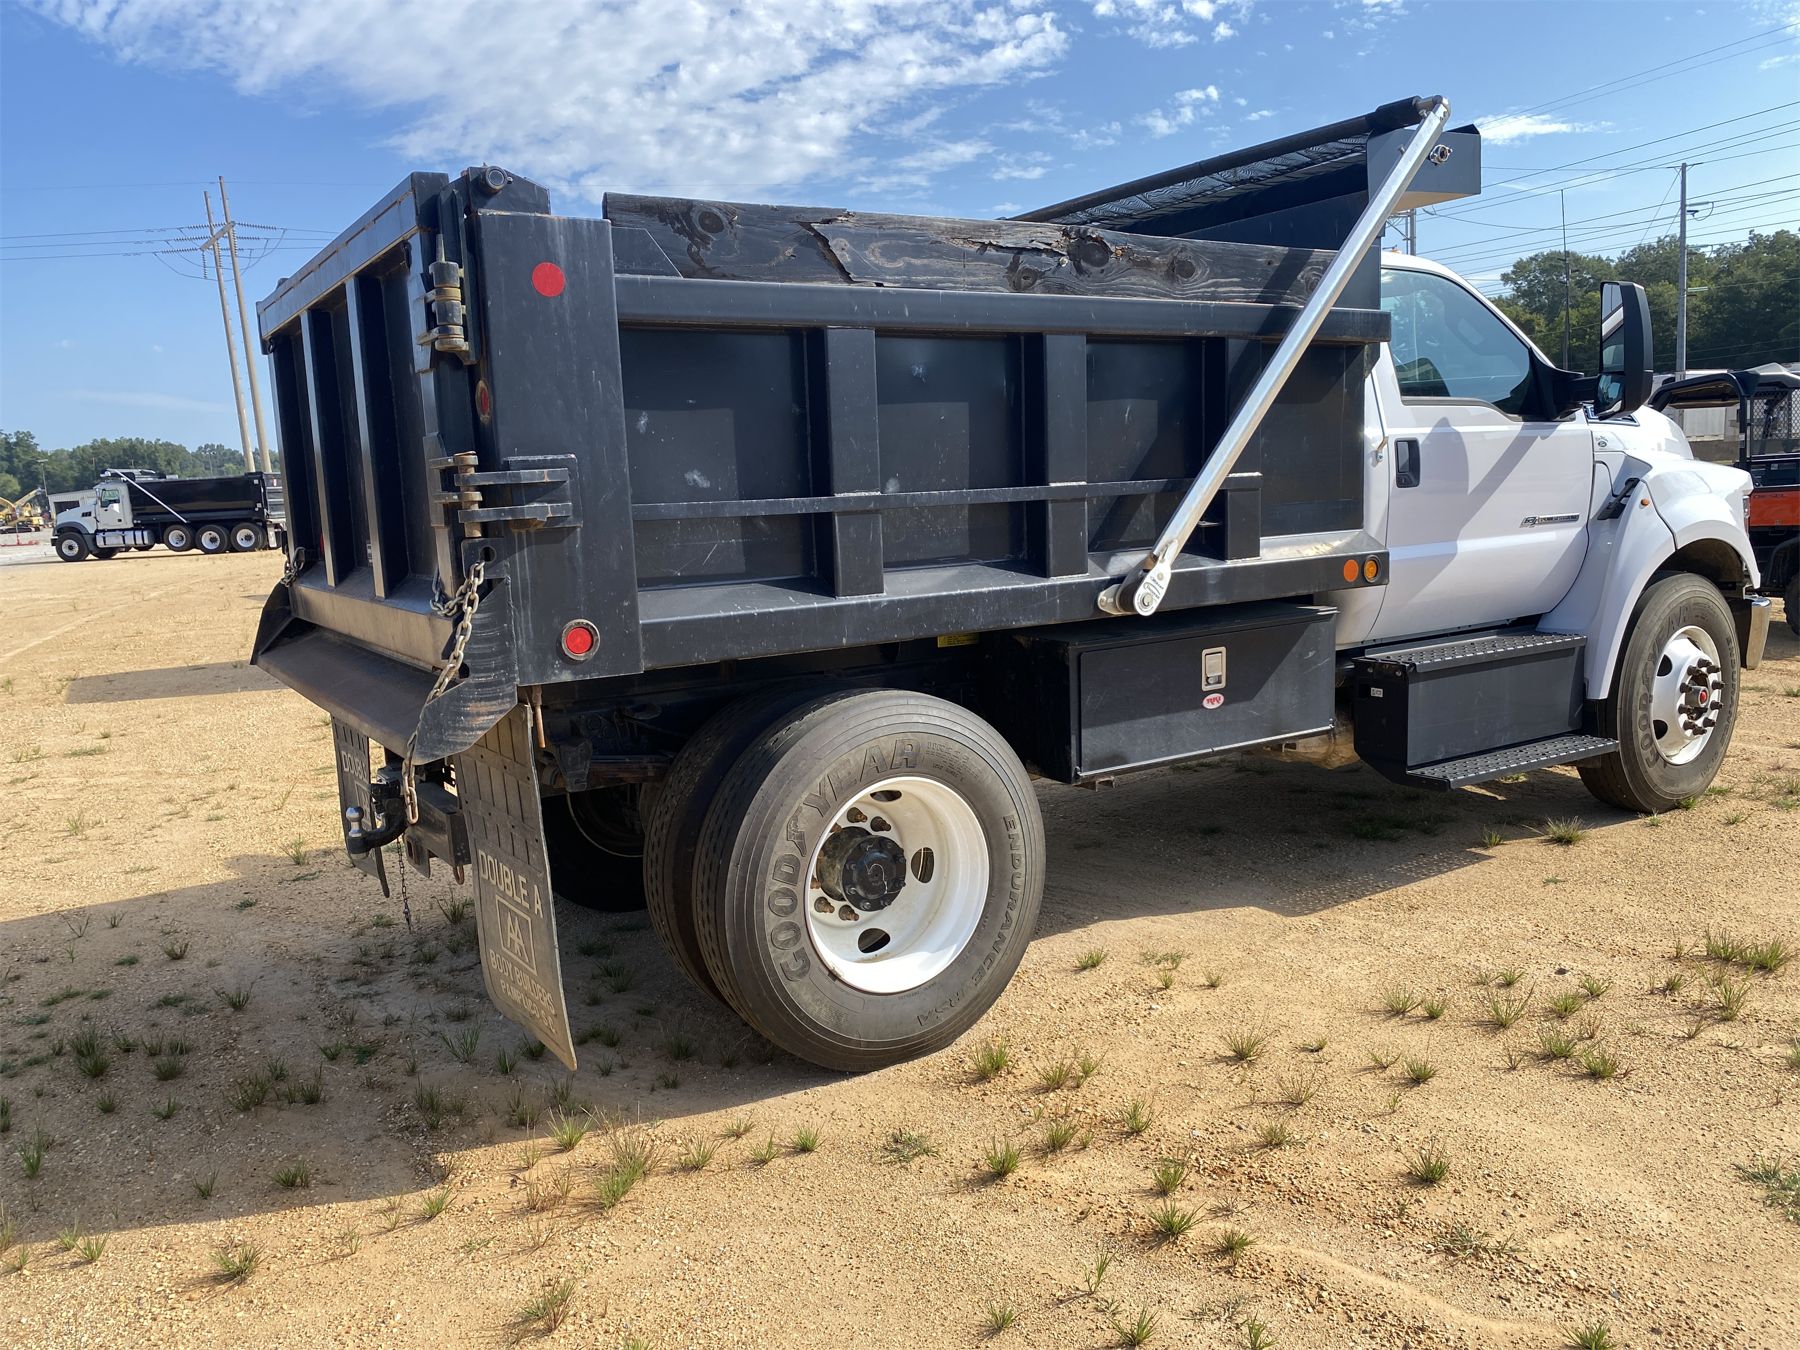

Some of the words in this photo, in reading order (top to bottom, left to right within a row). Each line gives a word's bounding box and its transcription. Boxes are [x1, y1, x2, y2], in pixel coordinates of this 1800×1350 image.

[478, 850, 530, 909] DOUBLE
[534, 885, 543, 918] A
[767, 738, 921, 982] GOODYEAR
[971, 815, 1022, 986] ENDURANCE
[490, 949, 514, 981] BODY
[514, 966, 556, 1014] BUILDERS
